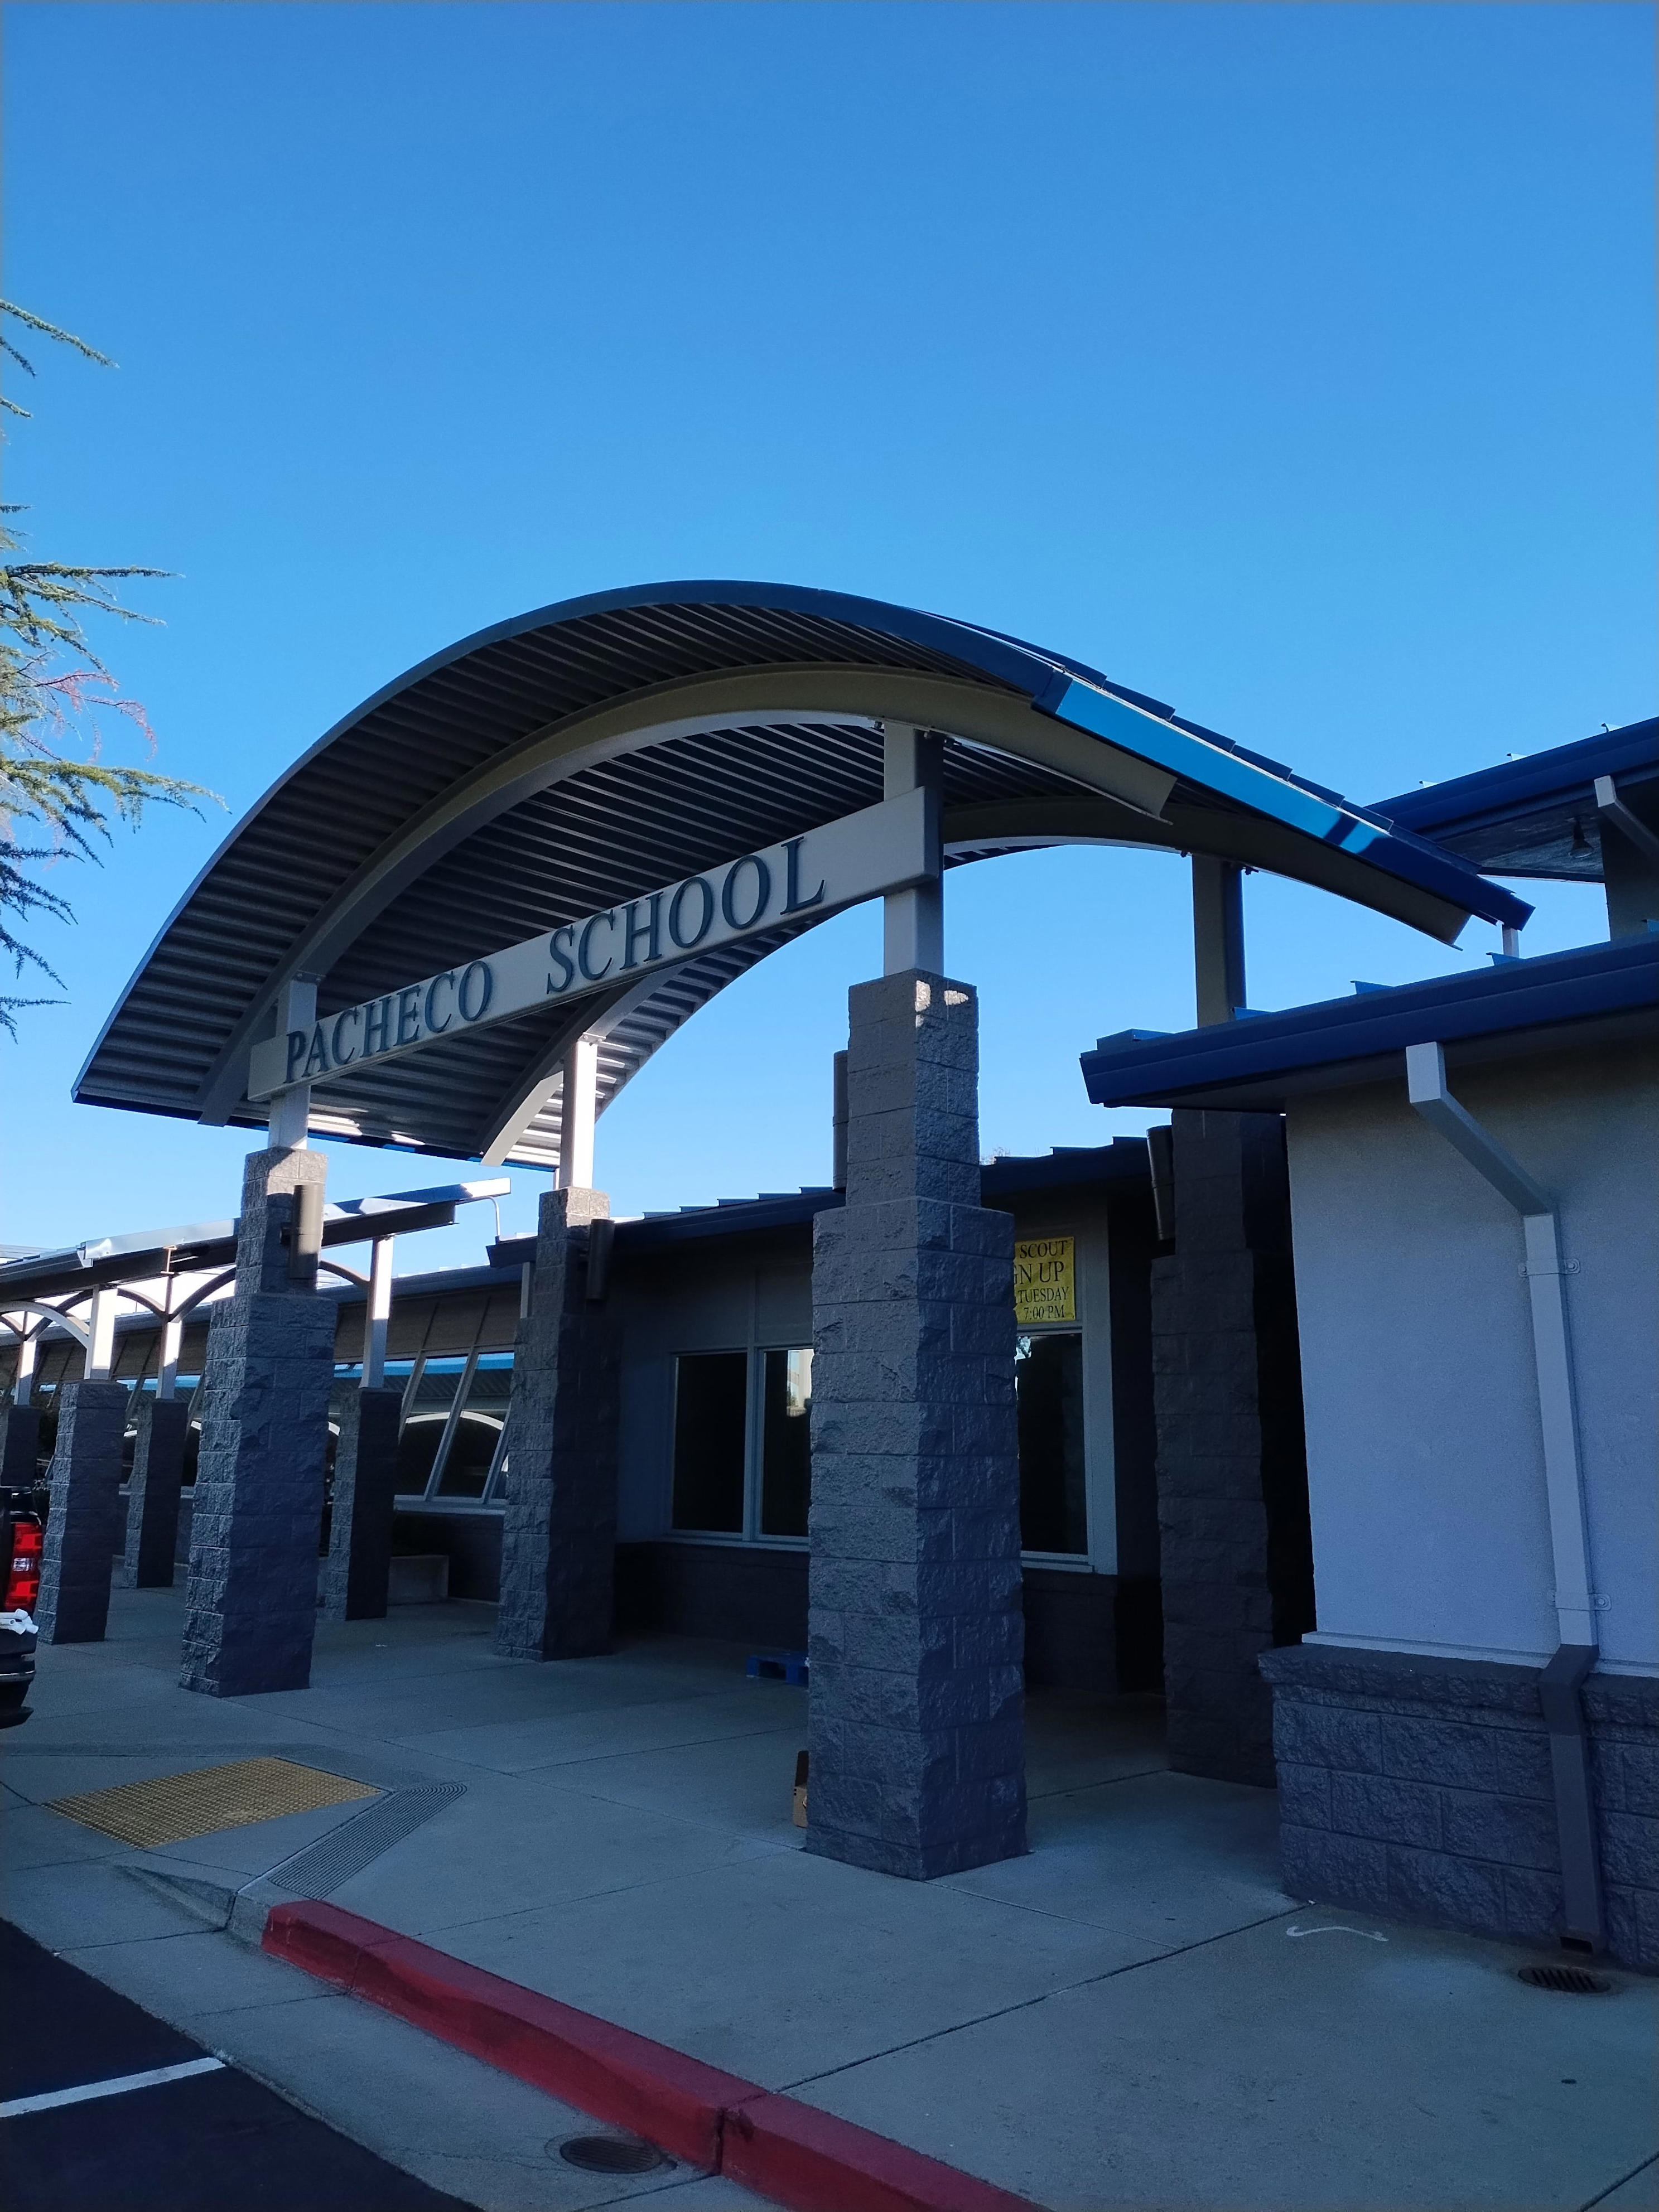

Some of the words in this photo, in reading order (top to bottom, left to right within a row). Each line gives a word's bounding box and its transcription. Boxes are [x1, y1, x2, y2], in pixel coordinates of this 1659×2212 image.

[283, 960, 493, 1084] PACHECO
[546, 836, 826, 995] SCHOOL
[1019, 1240, 1068, 1259] SCOUT
[1039, 1261, 1064, 1283] UP
[1017, 1286, 1069, 1303] TUESDAY
[1023, 1306, 1044, 1320] 7:00
[1047, 1305, 1065, 1318] PM
